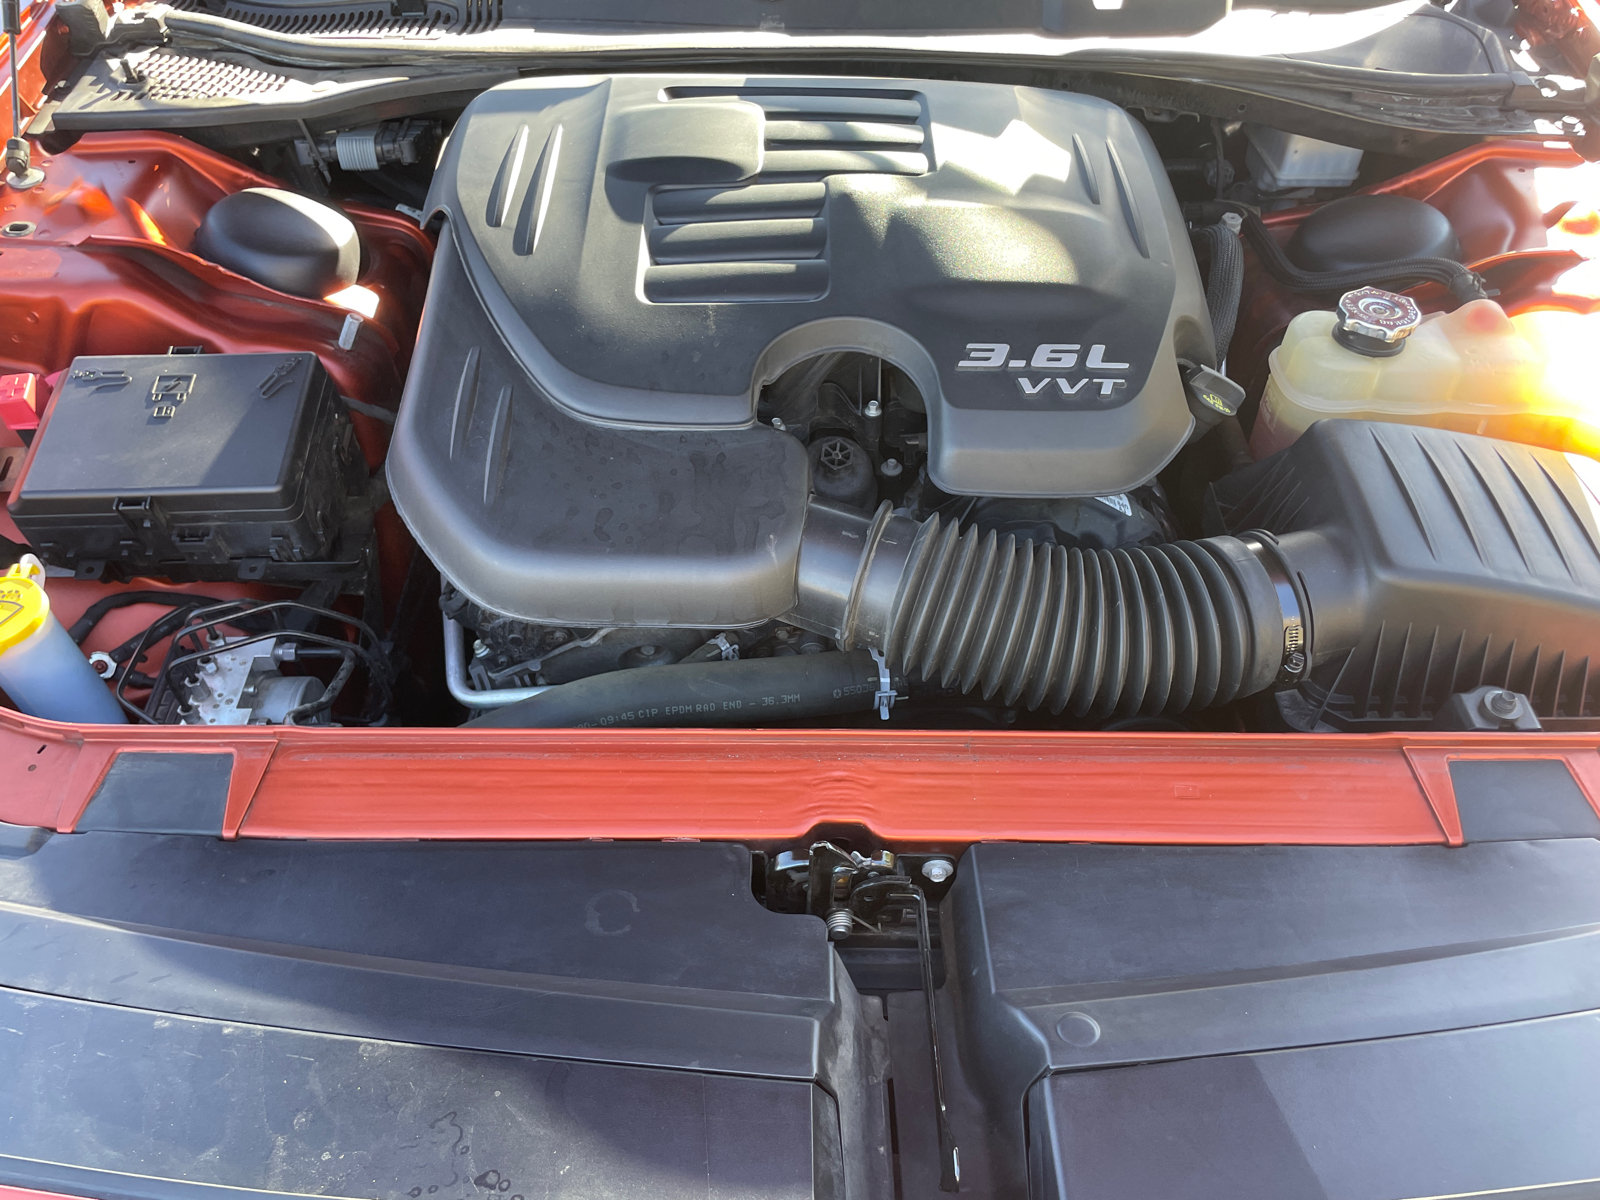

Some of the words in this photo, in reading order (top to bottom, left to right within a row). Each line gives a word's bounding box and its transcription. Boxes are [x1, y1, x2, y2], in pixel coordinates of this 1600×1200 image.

[956, 343, 1130, 369] 3.6L
[1017, 377, 1126, 396] VVT
[665, 705, 693, 715] EPDM
[696, 702, 716, 713] RAD
[723, 700, 742, 710] END
[761, 693, 800, 706] 36.3MM
